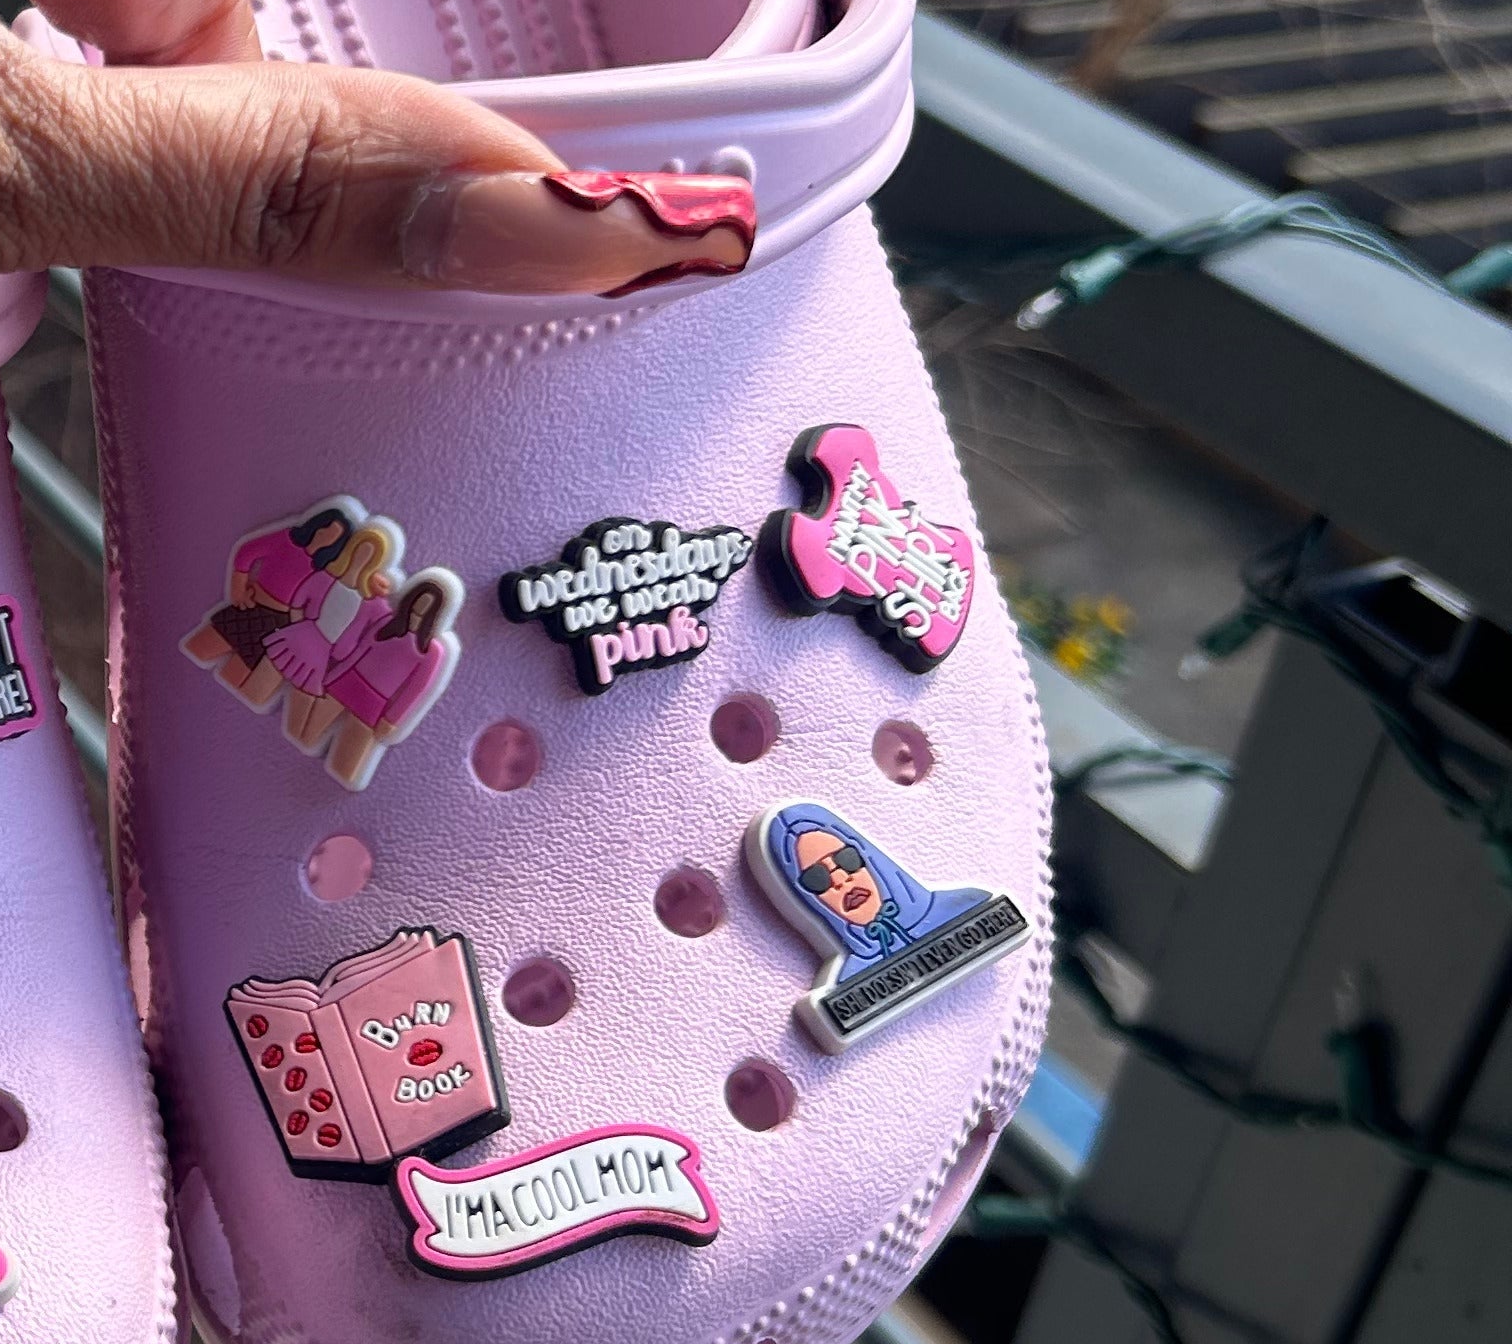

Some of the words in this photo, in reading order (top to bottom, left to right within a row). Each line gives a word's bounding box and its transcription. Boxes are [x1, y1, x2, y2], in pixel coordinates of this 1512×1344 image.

[517, 528, 753, 612] wednesdays
[602, 525, 652, 554] on
[849, 480, 910, 598] PINK
[883, 505, 955, 638] SHIRT
[563, 597, 618, 632] we
[620, 573, 718, 619] wear
[590, 606, 709, 684] pink
[920, 937, 963, 973] EVEN
[954, 924, 986, 951] GO
[395, 1064, 471, 1102] BOOK
[511, 1158, 599, 1227] COOL
[595, 1147, 675, 1198] MOM
